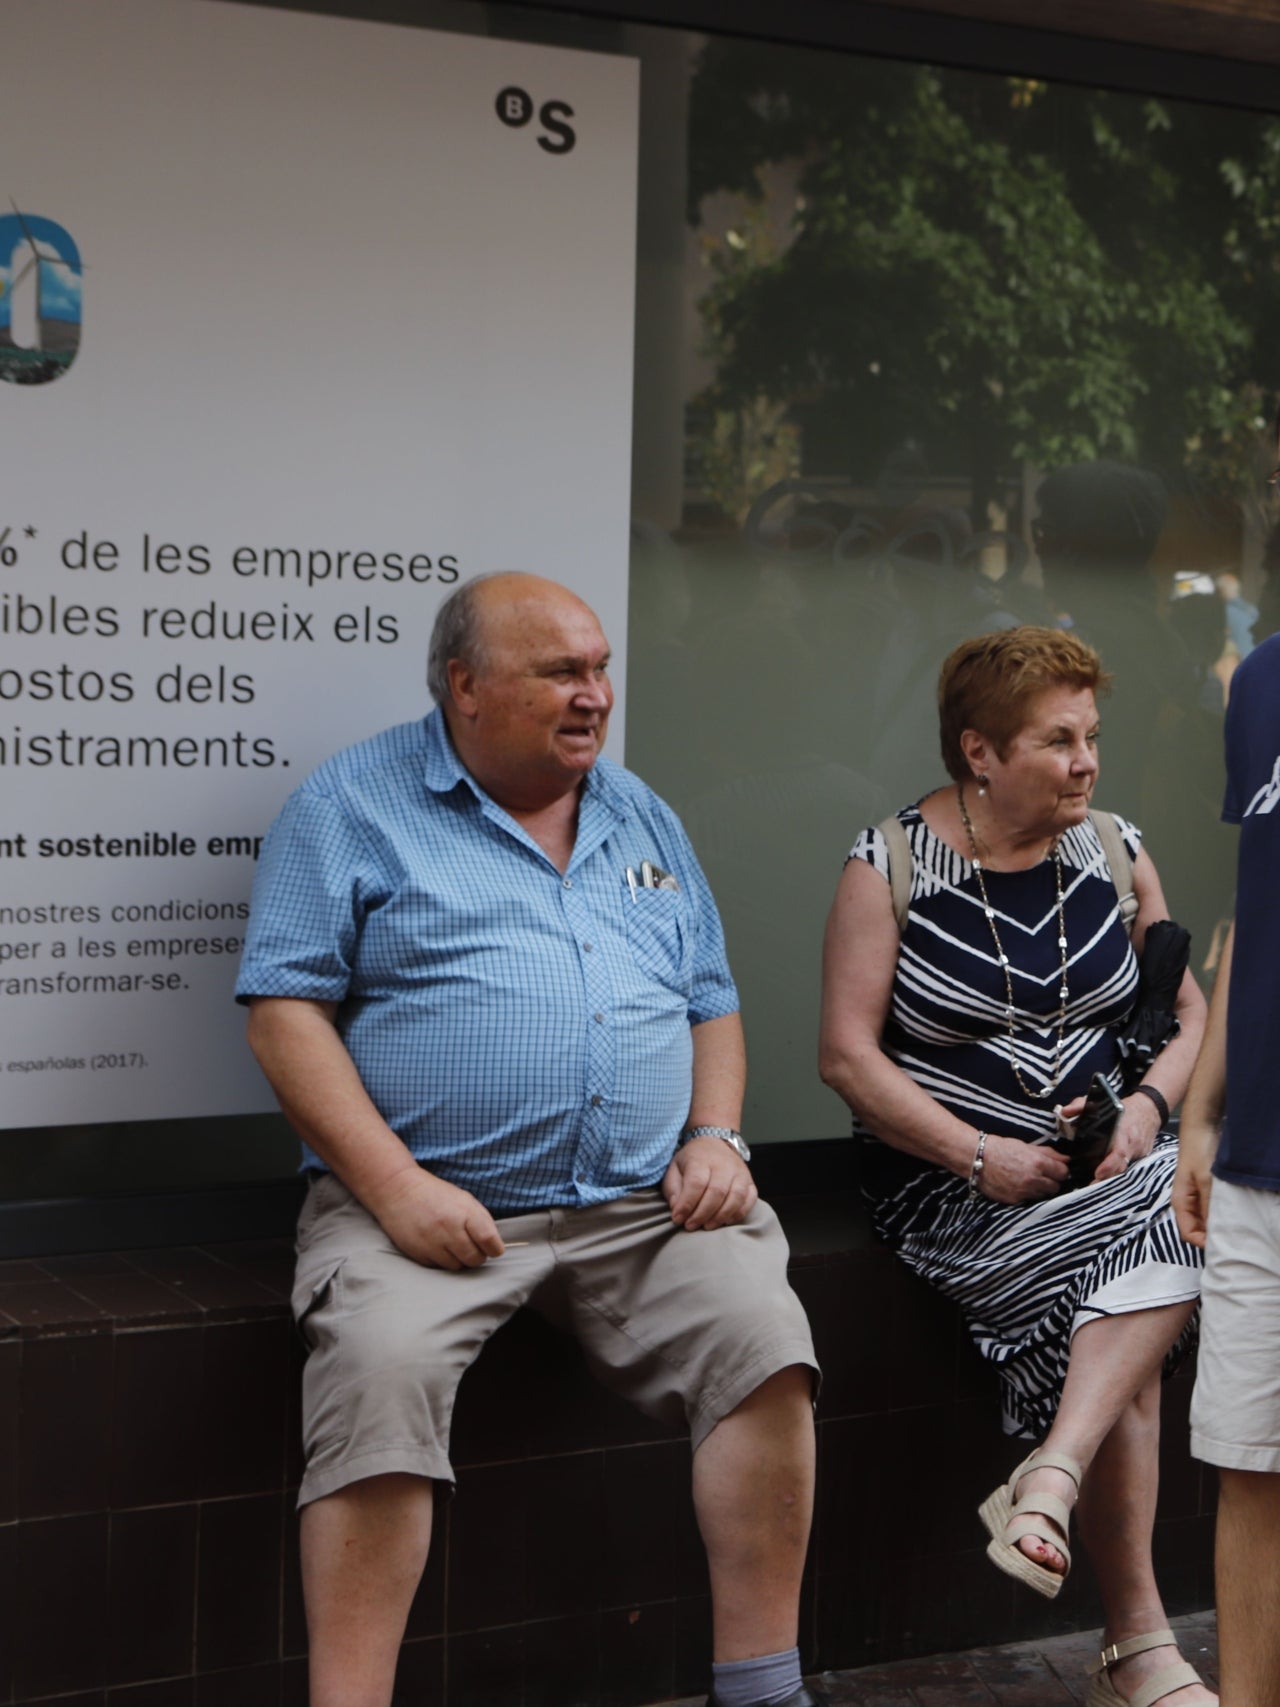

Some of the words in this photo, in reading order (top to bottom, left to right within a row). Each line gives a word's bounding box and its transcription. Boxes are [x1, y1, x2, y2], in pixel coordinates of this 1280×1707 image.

[61, 530, 119, 572] de
[144, 534, 211, 575] les
[232, 543, 460, 587] empreses
[2, 594, 119, 637] ibles
[143, 600, 314, 642] redueix
[334, 605, 399, 644] els
[0, 663, 134, 702] ostos
[156, 664, 255, 704] dels
[0, 834, 26, 858] nt
[38, 832, 196, 858] sostenible
[0, 903, 101, 924] nostres
[111, 899, 249, 923] condicions
[0, 942, 41, 964] per
[51, 943, 66, 958] a
[78, 936, 116, 958] les
